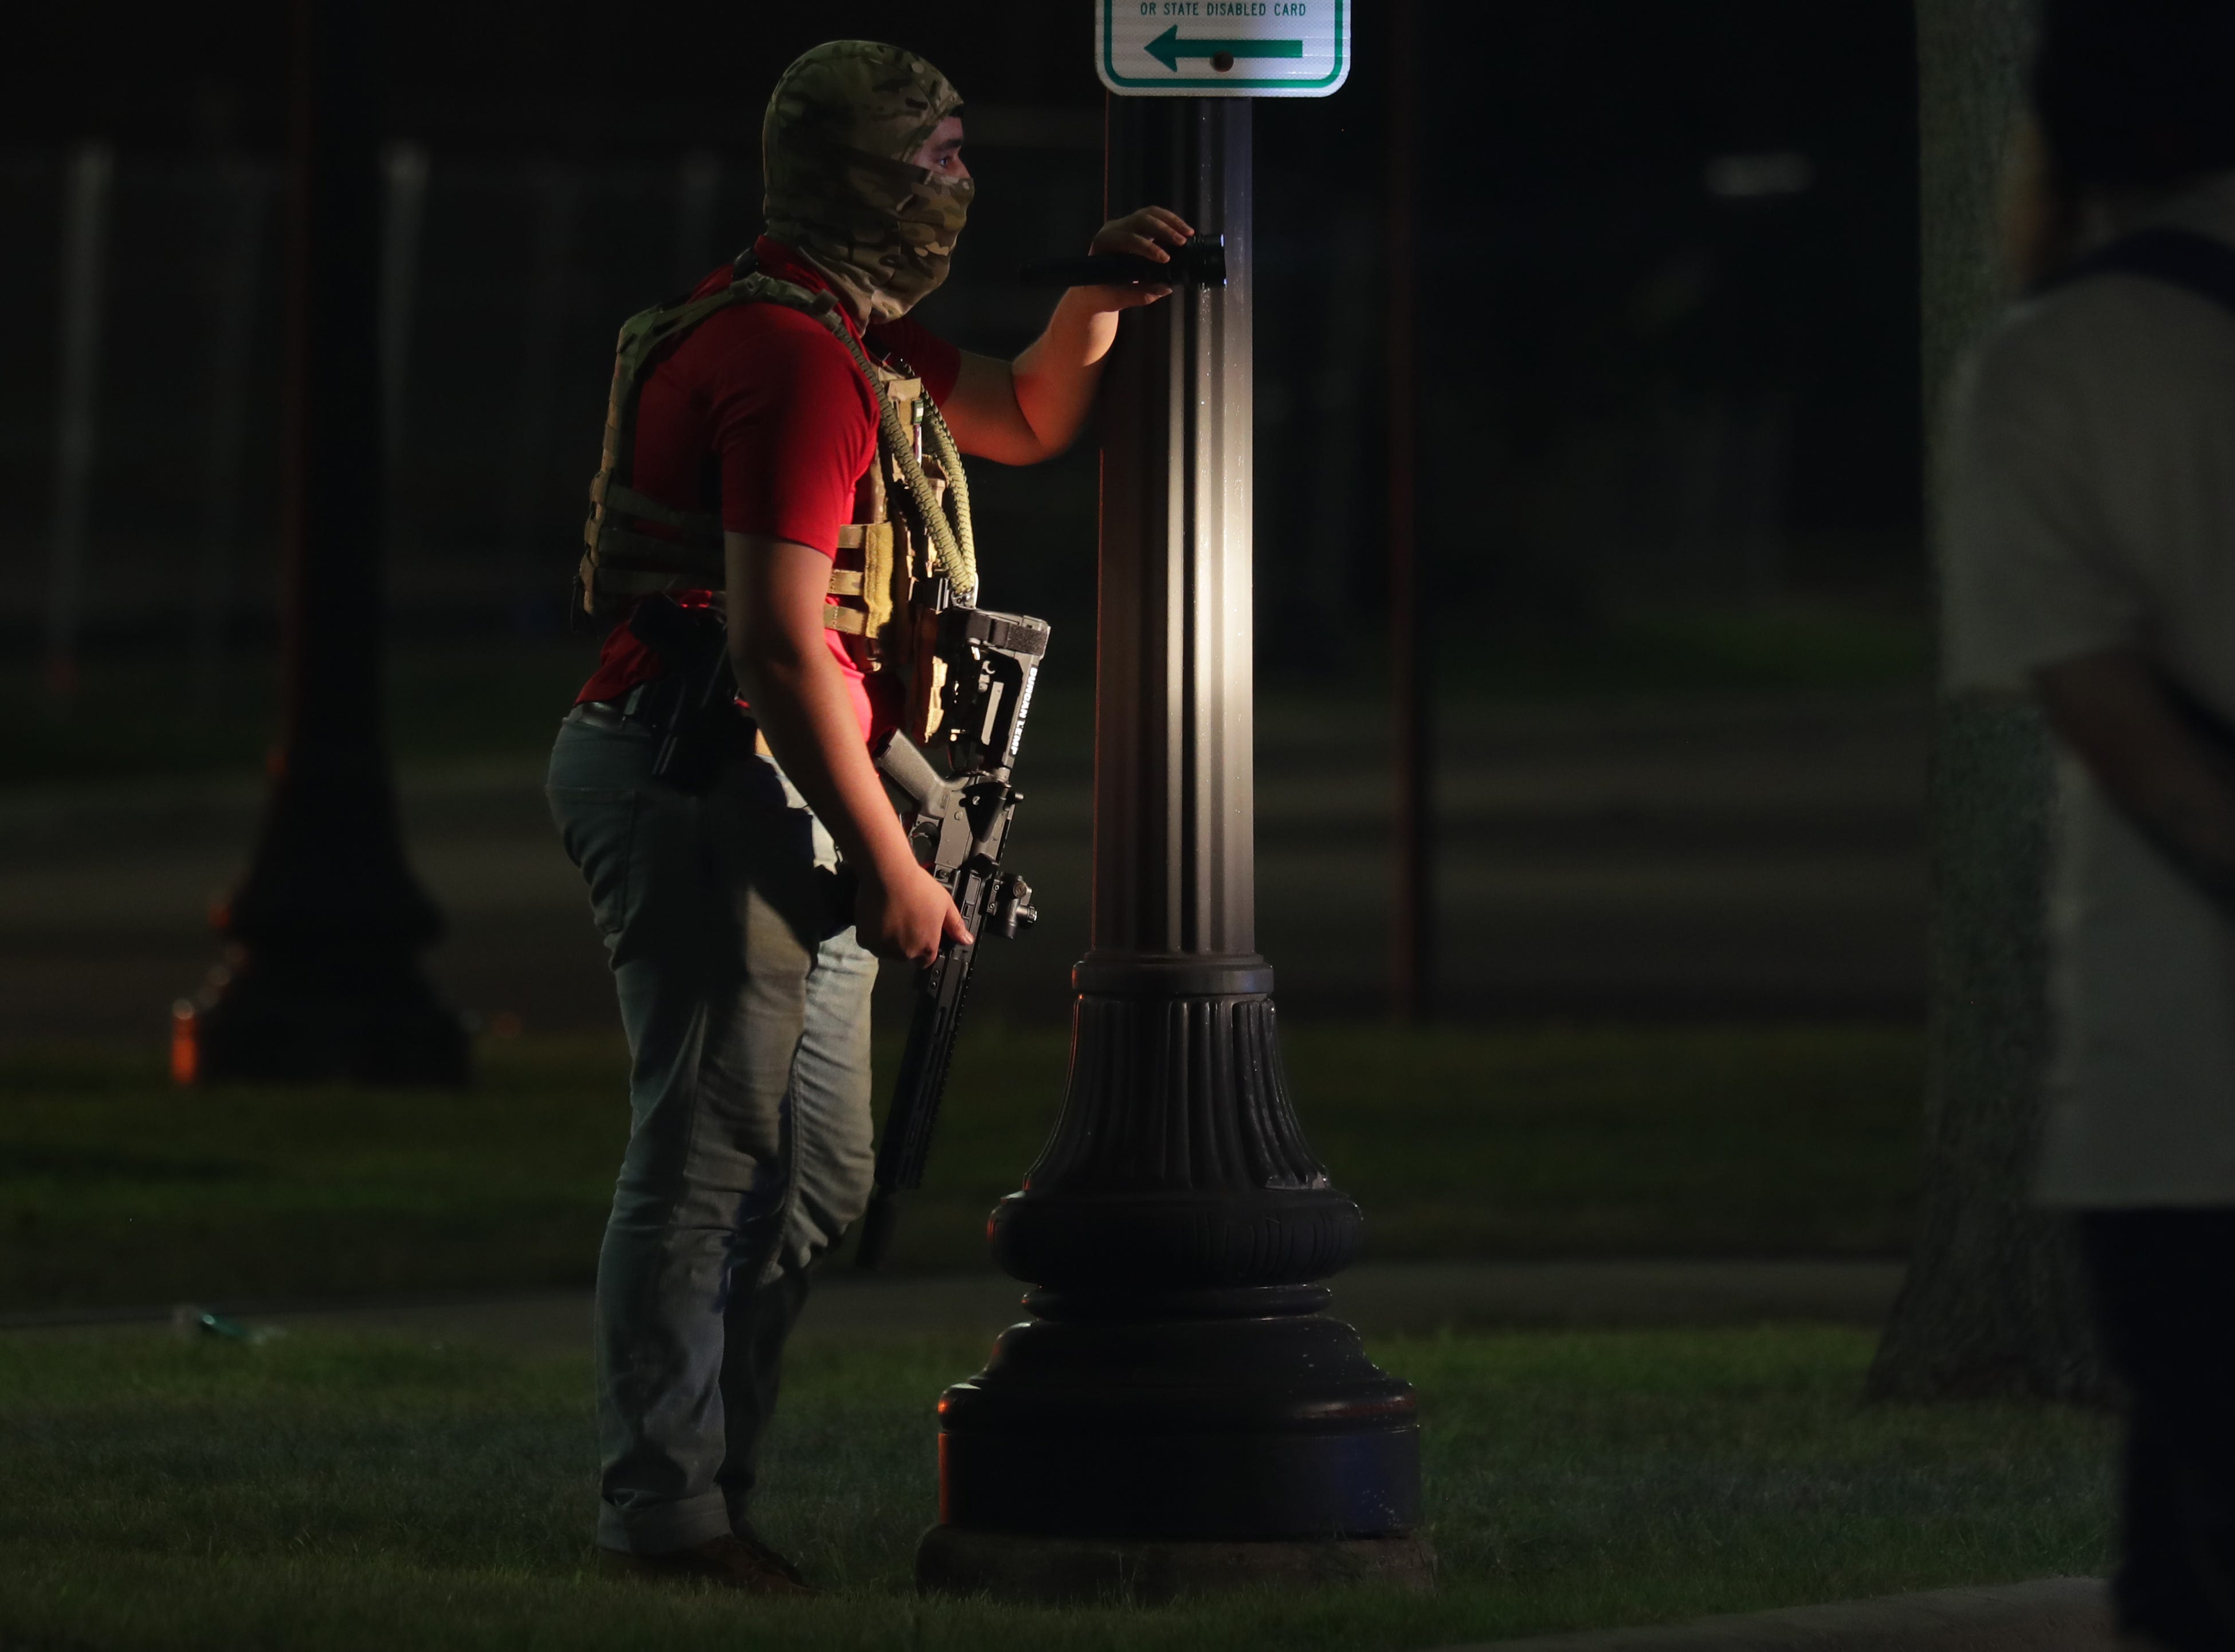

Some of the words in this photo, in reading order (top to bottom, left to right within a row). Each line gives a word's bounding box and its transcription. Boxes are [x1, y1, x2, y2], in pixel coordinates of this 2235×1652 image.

[1140, 2, 1156, 16] OR
[1163, 2, 1199, 16] STATE
[1206, 2, 1266, 16] DISABLED
[1274, 2, 1306, 16] CARD
[1019, 667, 1038, 719] DUNCAN
